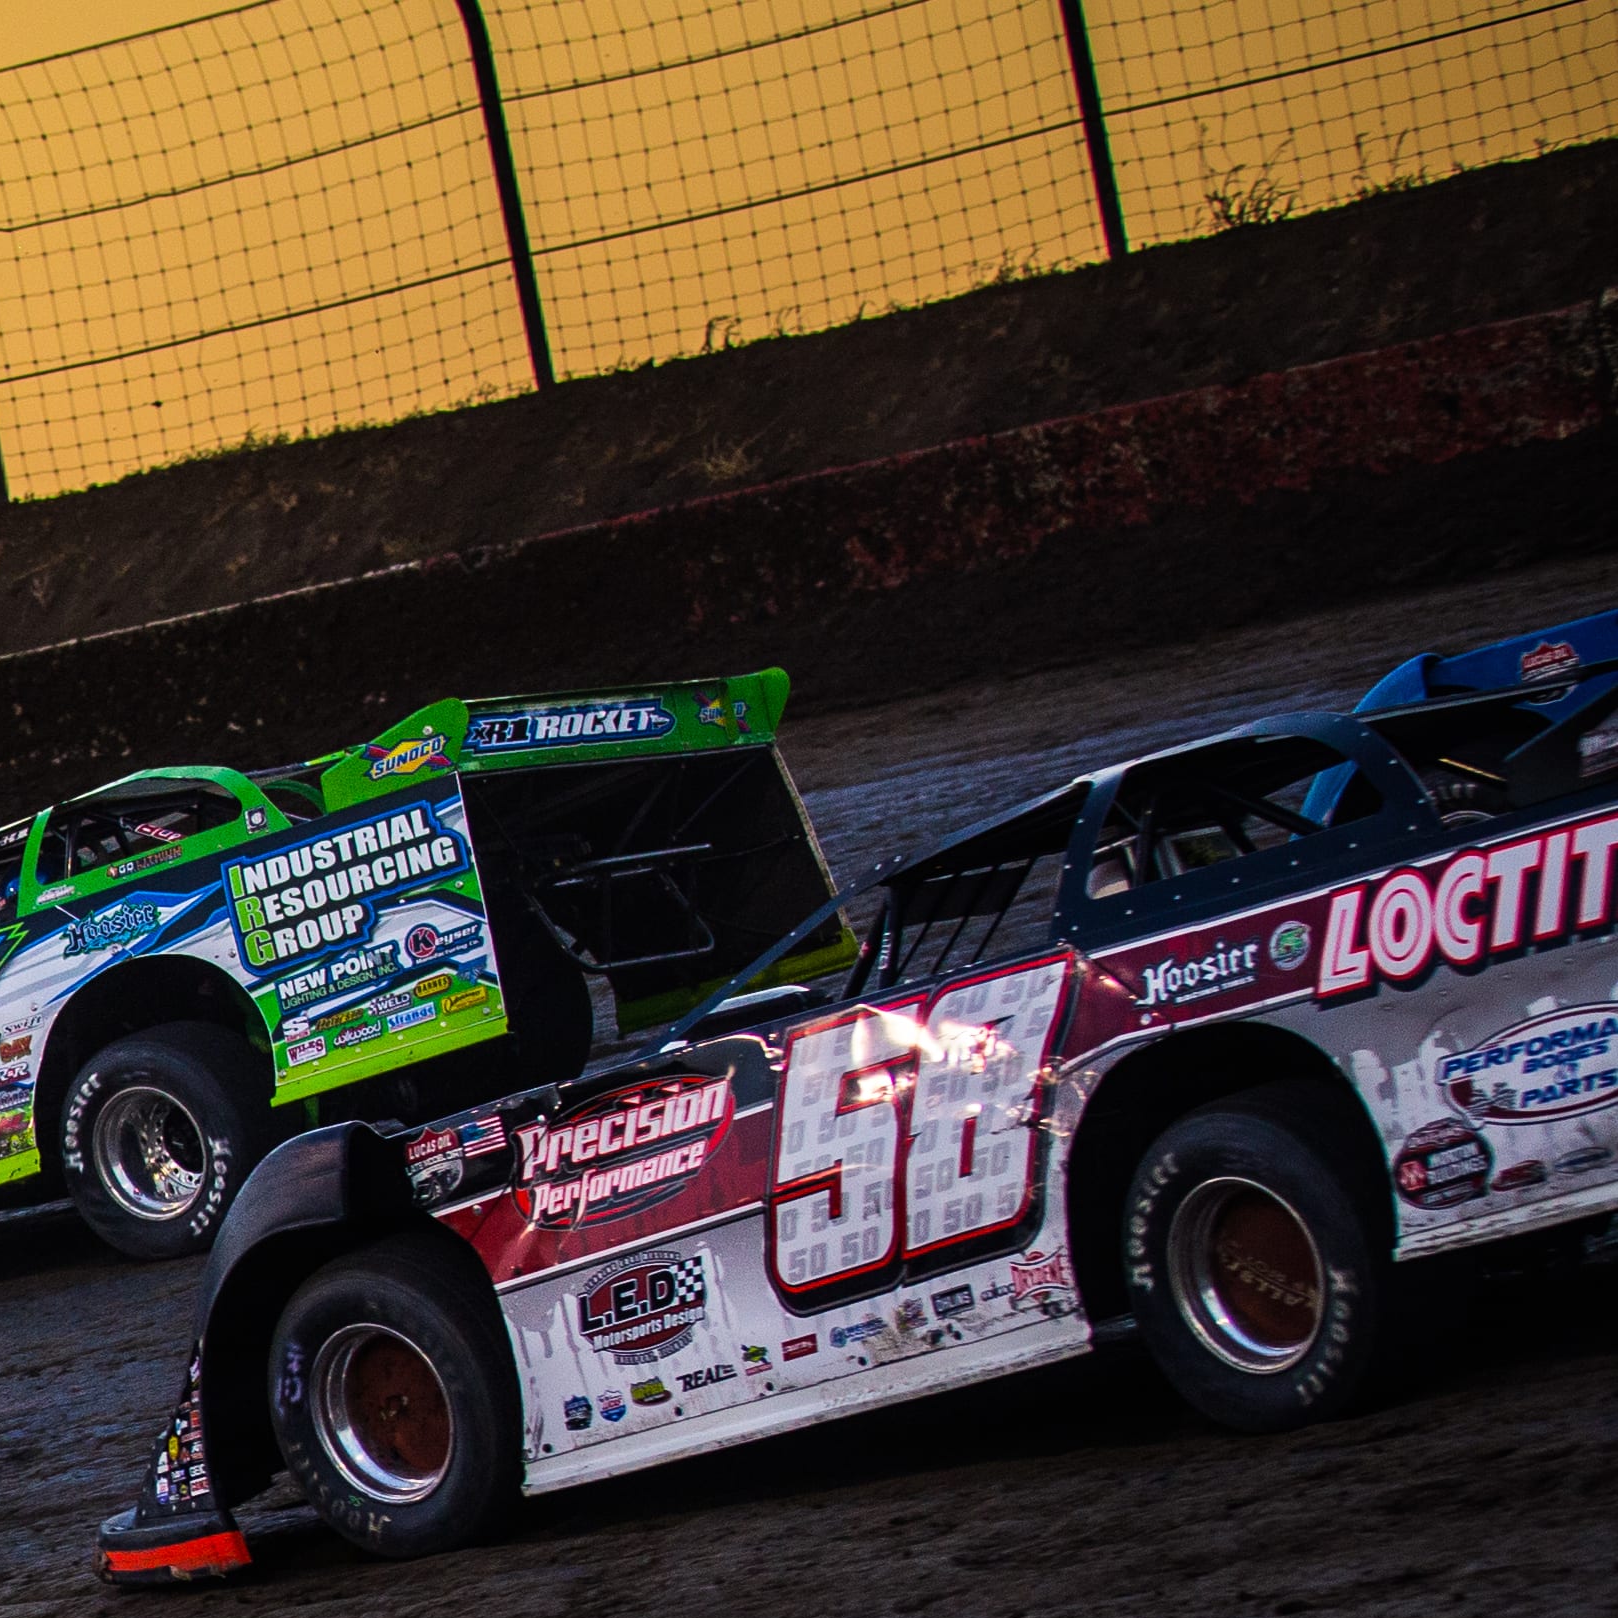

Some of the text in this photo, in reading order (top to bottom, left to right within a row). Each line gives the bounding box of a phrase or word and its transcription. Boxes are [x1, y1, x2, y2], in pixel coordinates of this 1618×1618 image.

[534, 707, 650, 740] ROCKET
[373, 736, 443, 778] SUNOCO
[228, 808, 431, 900] INDUSTRIAL
[235, 836, 457, 933] RESOURCING
[65, 902, 156, 954] Hoosier
[244, 903, 365, 967] GROUP
[413, 926, 479, 957] Keyser
[278, 944, 394, 999] NEW POINT
[282, 987, 328, 1010] LIGHTING
[378, 964, 398, 977] INC.
[1136, 938, 1258, 1005] Hoosier
[376, 993, 411, 1011] WELD
[1521, 1039, 1610, 1075] BODIES
[1520, 1067, 1618, 1109] PARTS
[408, 1136, 452, 1160] LUCAS OIL
[518, 1078, 730, 1181] Precision
[532, 1140, 708, 1222] Performance
[592, 1318, 663, 1352] Motorsports
[662, 1305, 705, 1330] Design
